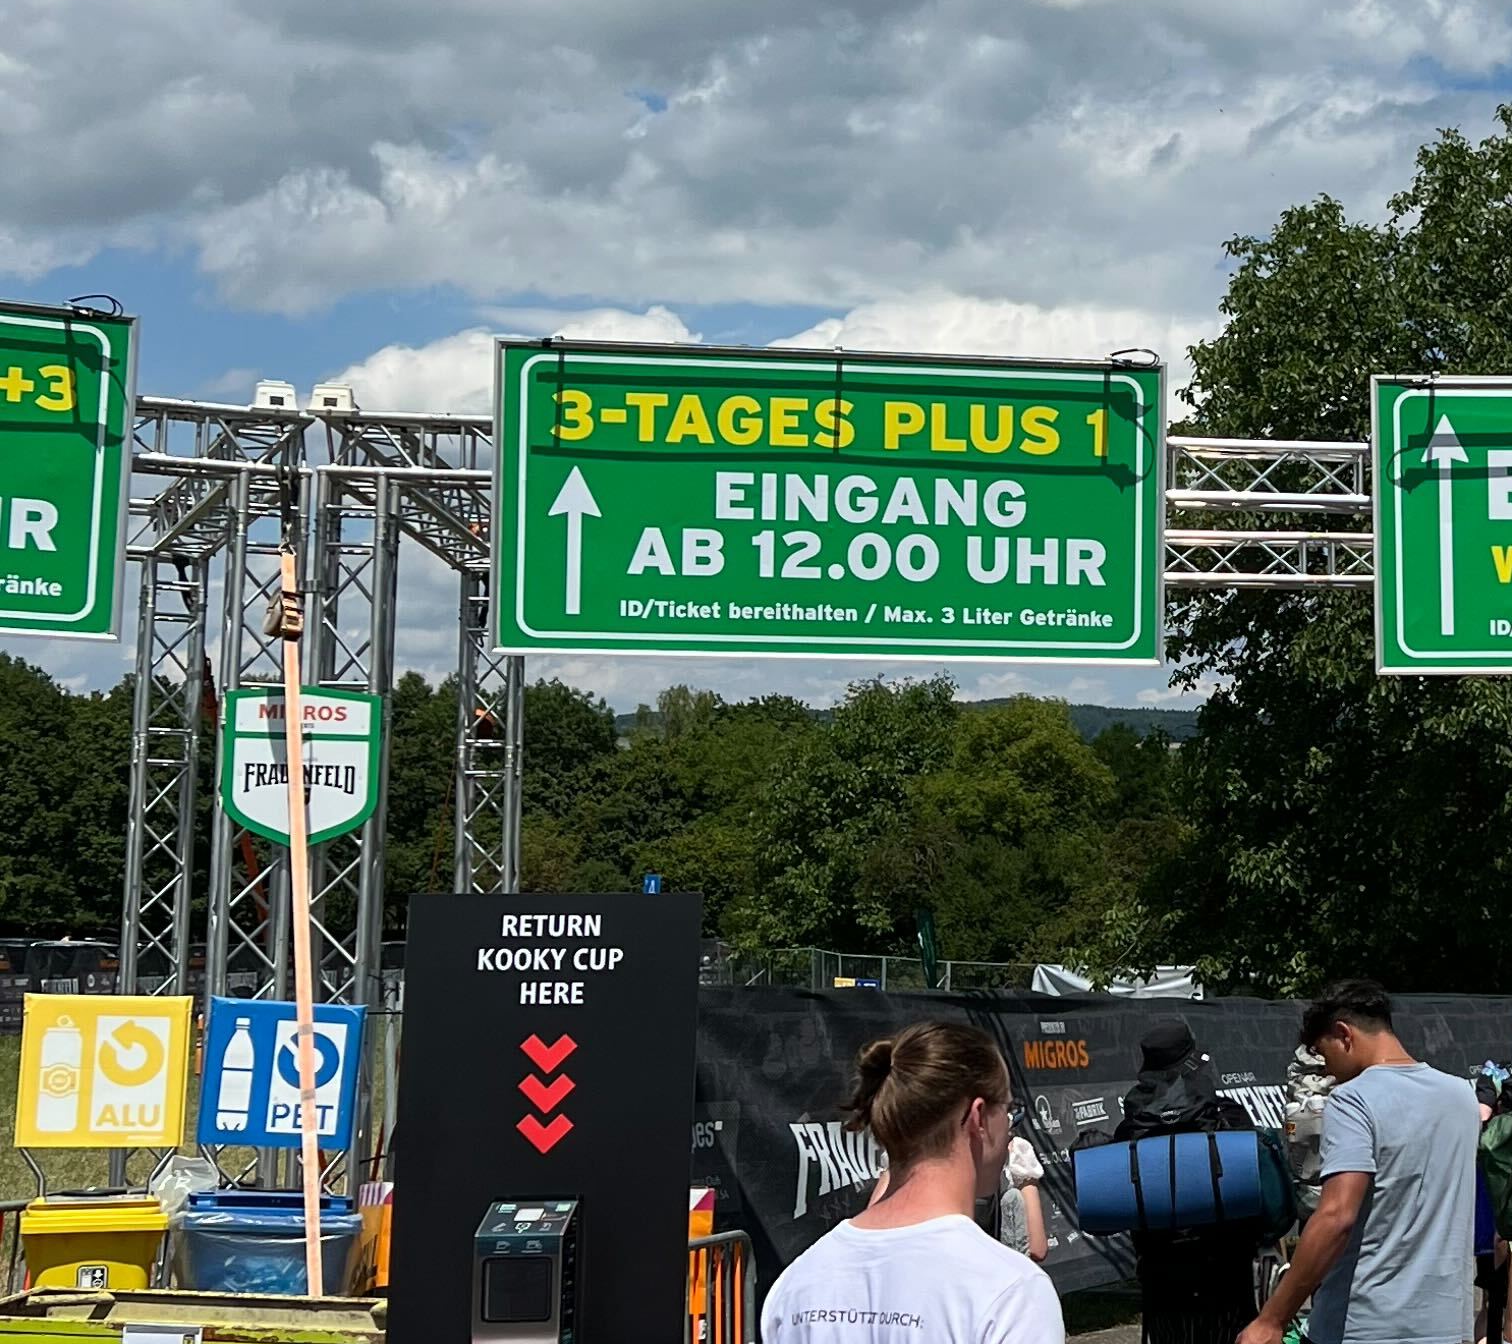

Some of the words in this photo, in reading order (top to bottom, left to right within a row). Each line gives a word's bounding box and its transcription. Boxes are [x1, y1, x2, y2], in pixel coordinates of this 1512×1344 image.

[549, 389, 856, 450] 3-TAGES
[884, 400, 1060, 456] PLUS
[1086, 407, 1108, 457] 1
[715, 471, 1027, 528] EINGANG
[627, 527, 725, 576] AB
[752, 530, 941, 582] 12.00
[964, 536, 1107, 587] UHR
[620, 599, 721, 621] ID/Ticket
[728, 602, 857, 624] bereithalten
[884, 605, 934, 625] Max.
[940, 606, 956, 625] 3
[963, 607, 1014, 626] Liter
[1019, 608, 1114, 629] Getränke
[259, 704, 347, 721] MIROS
[243, 763, 356, 795] FRAUNFELD
[502, 914, 602, 937] RETURN
[477, 948, 567, 971] KOOKY
[574, 947, 624, 971] CUP
[519, 982, 584, 1005] HERE
[1024, 1039, 1089, 1069] MIGROS
[96, 1103, 160, 1127] ALU
